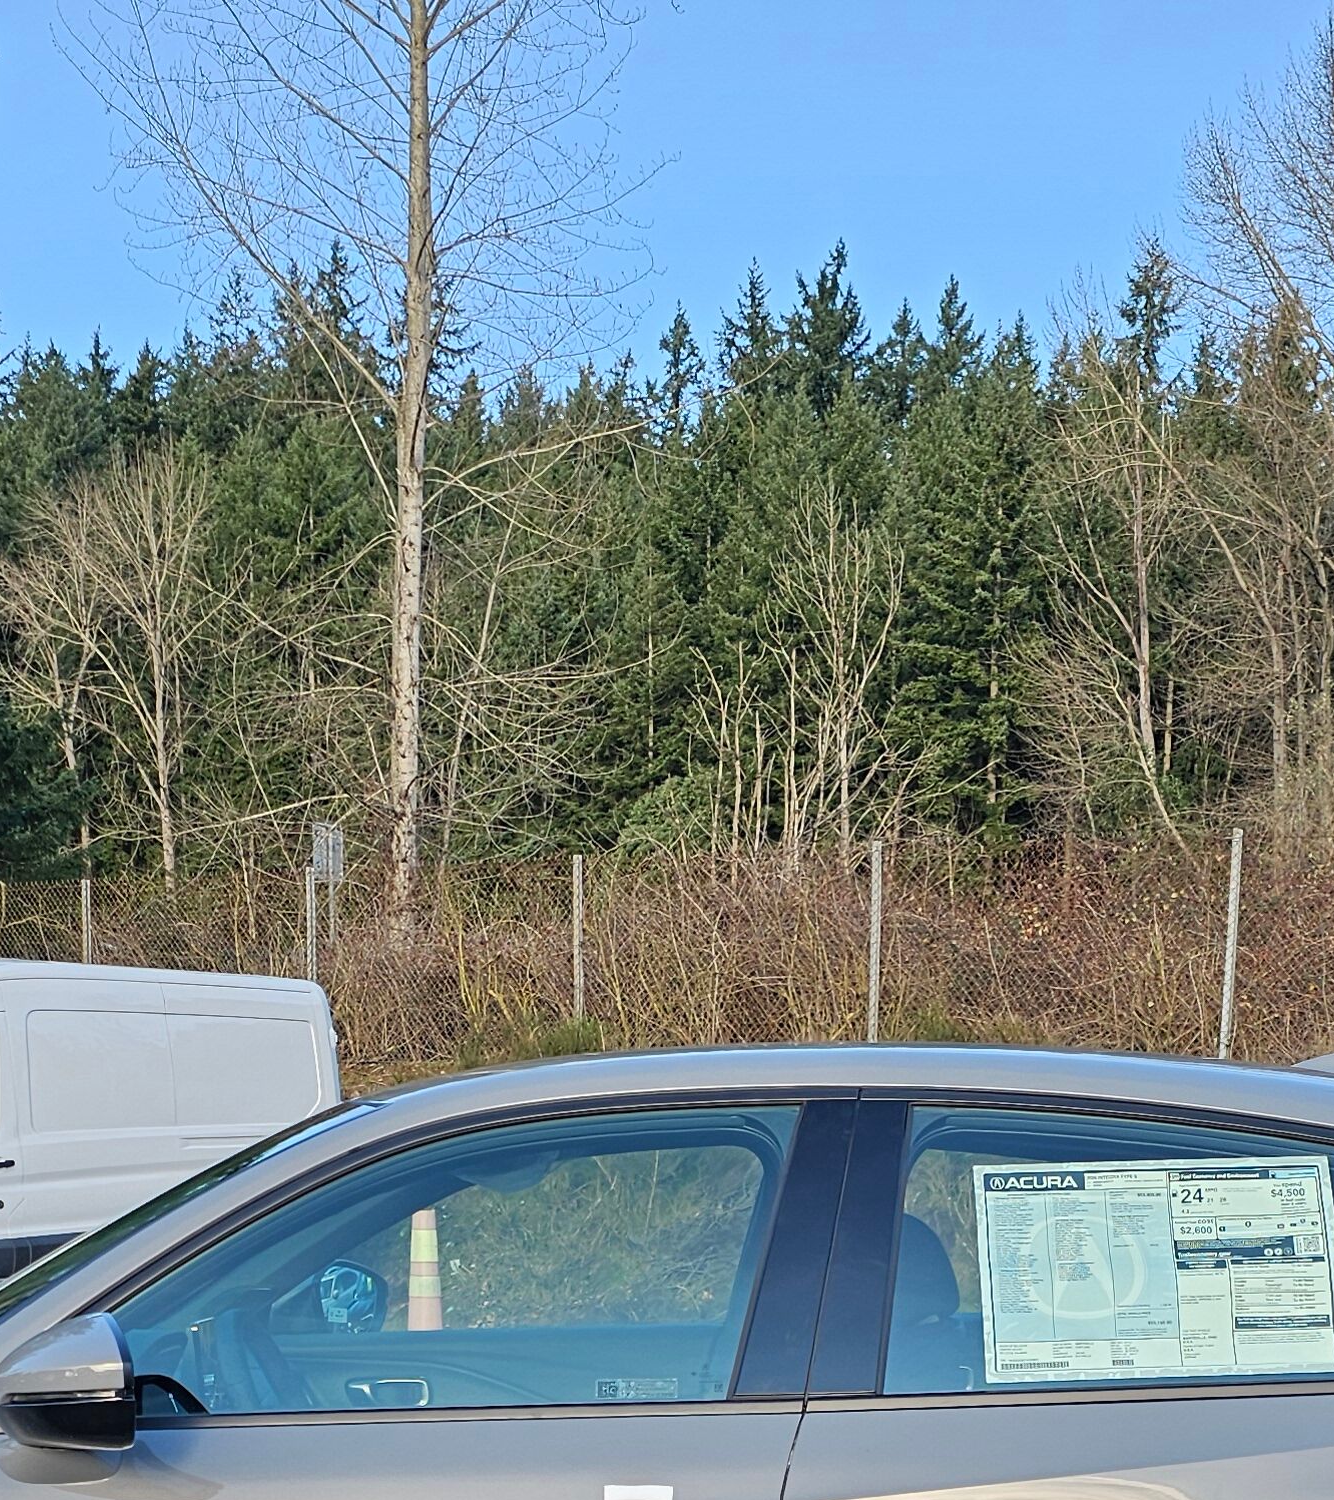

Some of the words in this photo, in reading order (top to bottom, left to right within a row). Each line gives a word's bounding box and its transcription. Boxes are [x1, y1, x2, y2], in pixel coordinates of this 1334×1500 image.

[1004, 1175, 1079, 1189] ACURA
[1180, 1188, 1204, 1204] 24
[1271, 1187, 1306, 1198] $4,500
[1179, 1226, 1213, 1235] $2,600
